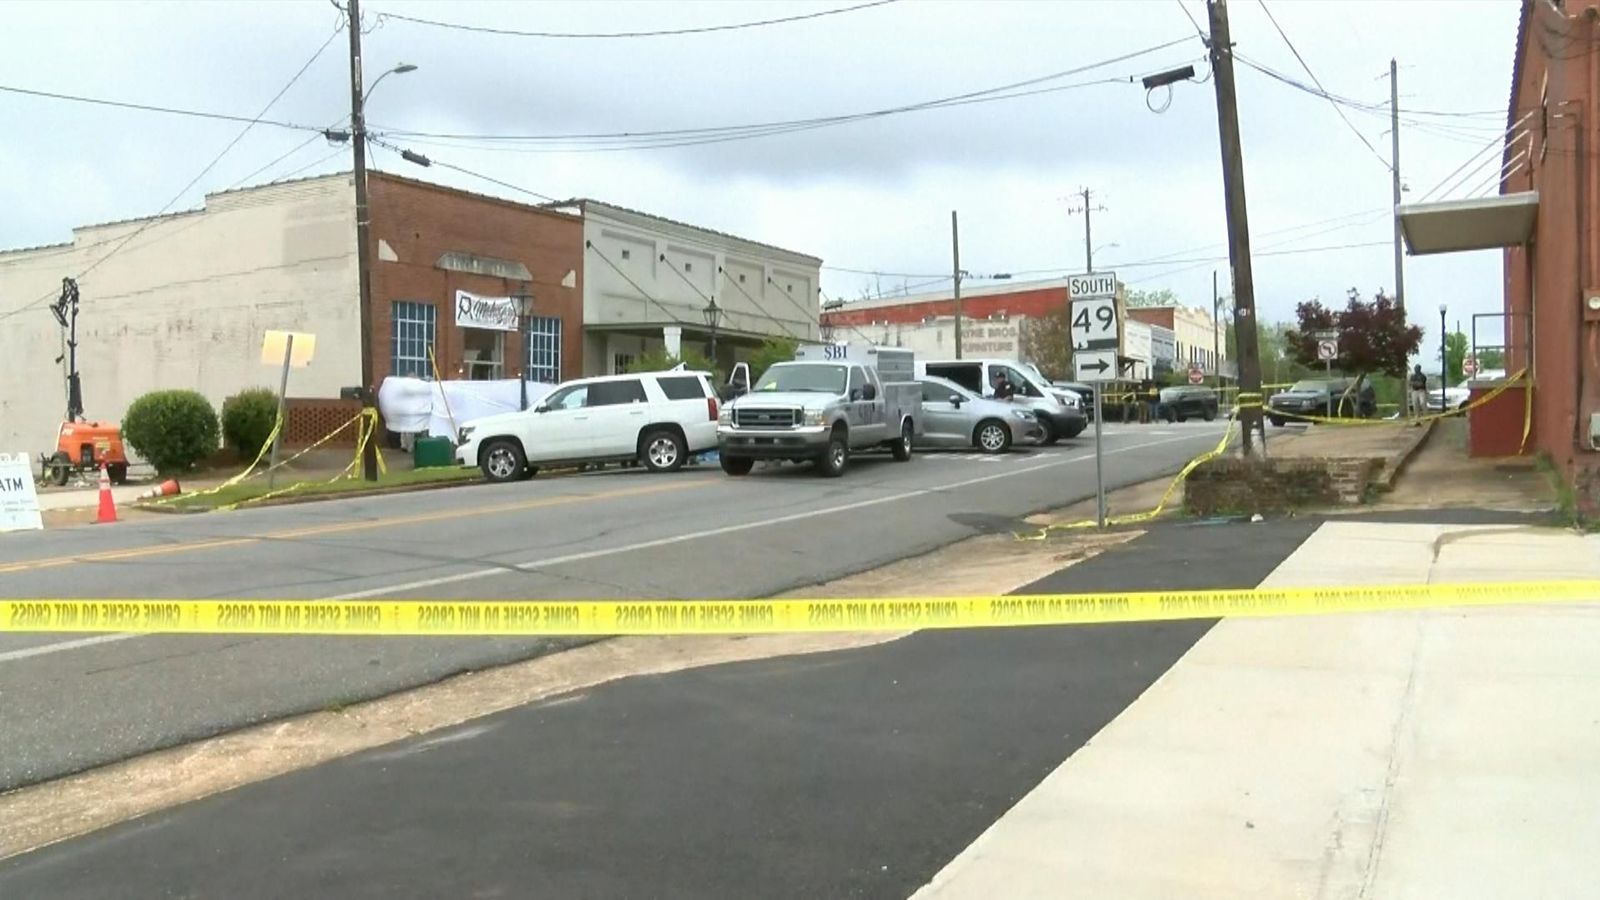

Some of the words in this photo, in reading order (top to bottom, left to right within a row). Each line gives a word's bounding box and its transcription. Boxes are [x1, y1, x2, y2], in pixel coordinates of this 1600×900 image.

[1072, 278, 1113, 295] SOUTH
[1073, 306, 1113, 333] 49
[824, 344, 848, 360] SBI
